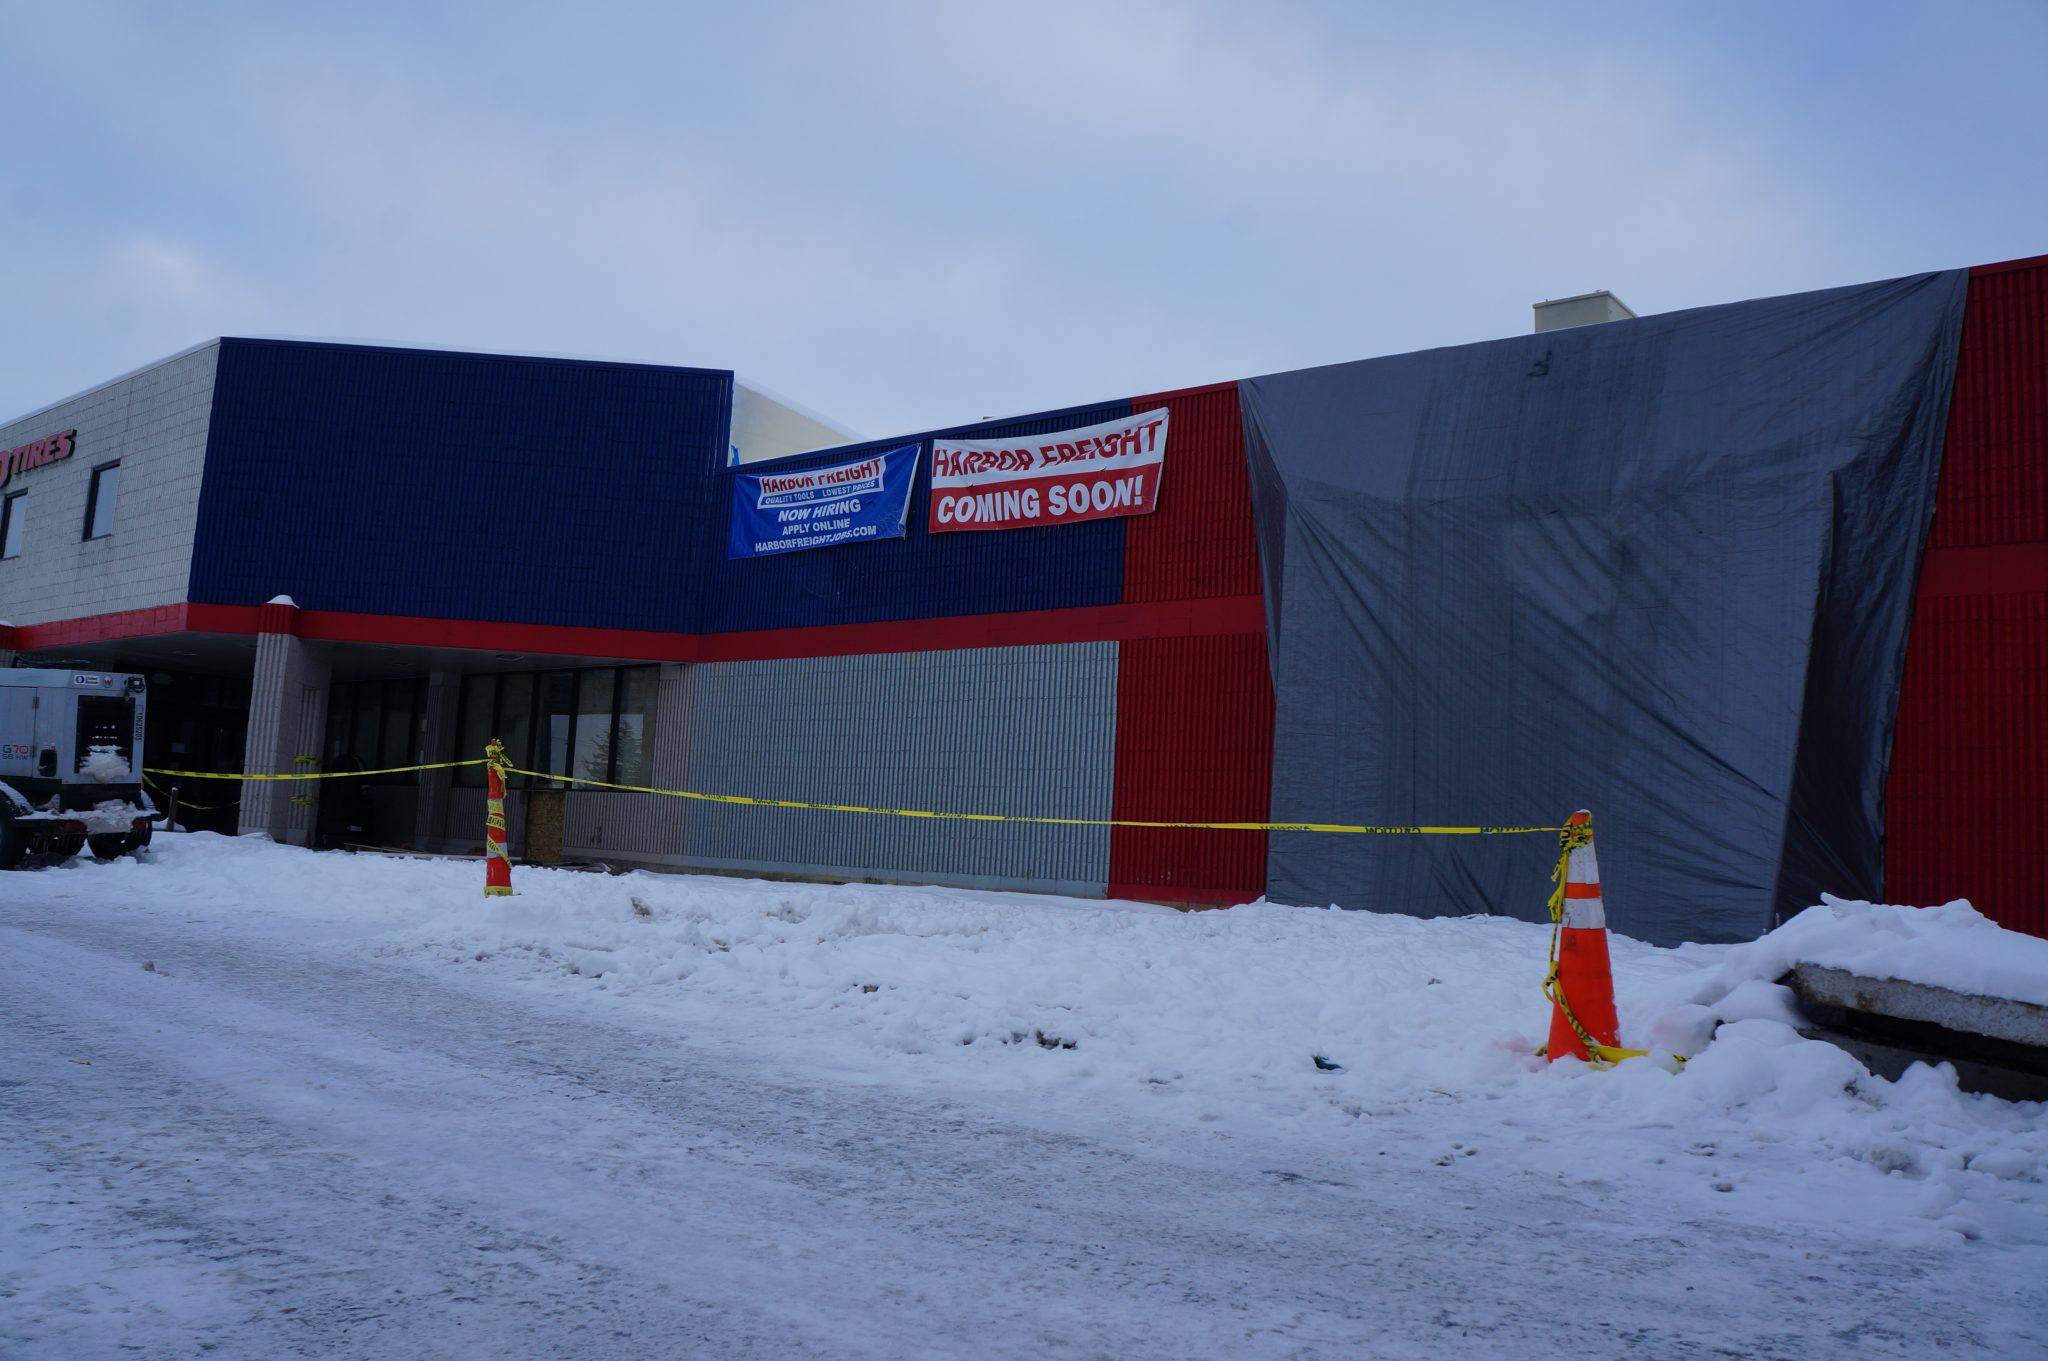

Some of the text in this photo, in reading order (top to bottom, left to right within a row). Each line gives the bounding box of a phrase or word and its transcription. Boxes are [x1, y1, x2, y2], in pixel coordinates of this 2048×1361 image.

[11, 429, 77, 475] TIRES
[932, 420, 1163, 478] HARBOR FREIGHT
[761, 458, 881, 494] HARBOR FREIGHT
[765, 480, 875, 504] QUALITY TOOLS LOWEST PRICES
[937, 474, 1143, 524] COMING SOON!
[778, 499, 861, 522] NOW HIRING
[755, 525, 877, 552] HARBORFREIGHTJOBS.COM
[782, 518, 851, 536] APPLY ONLINE
